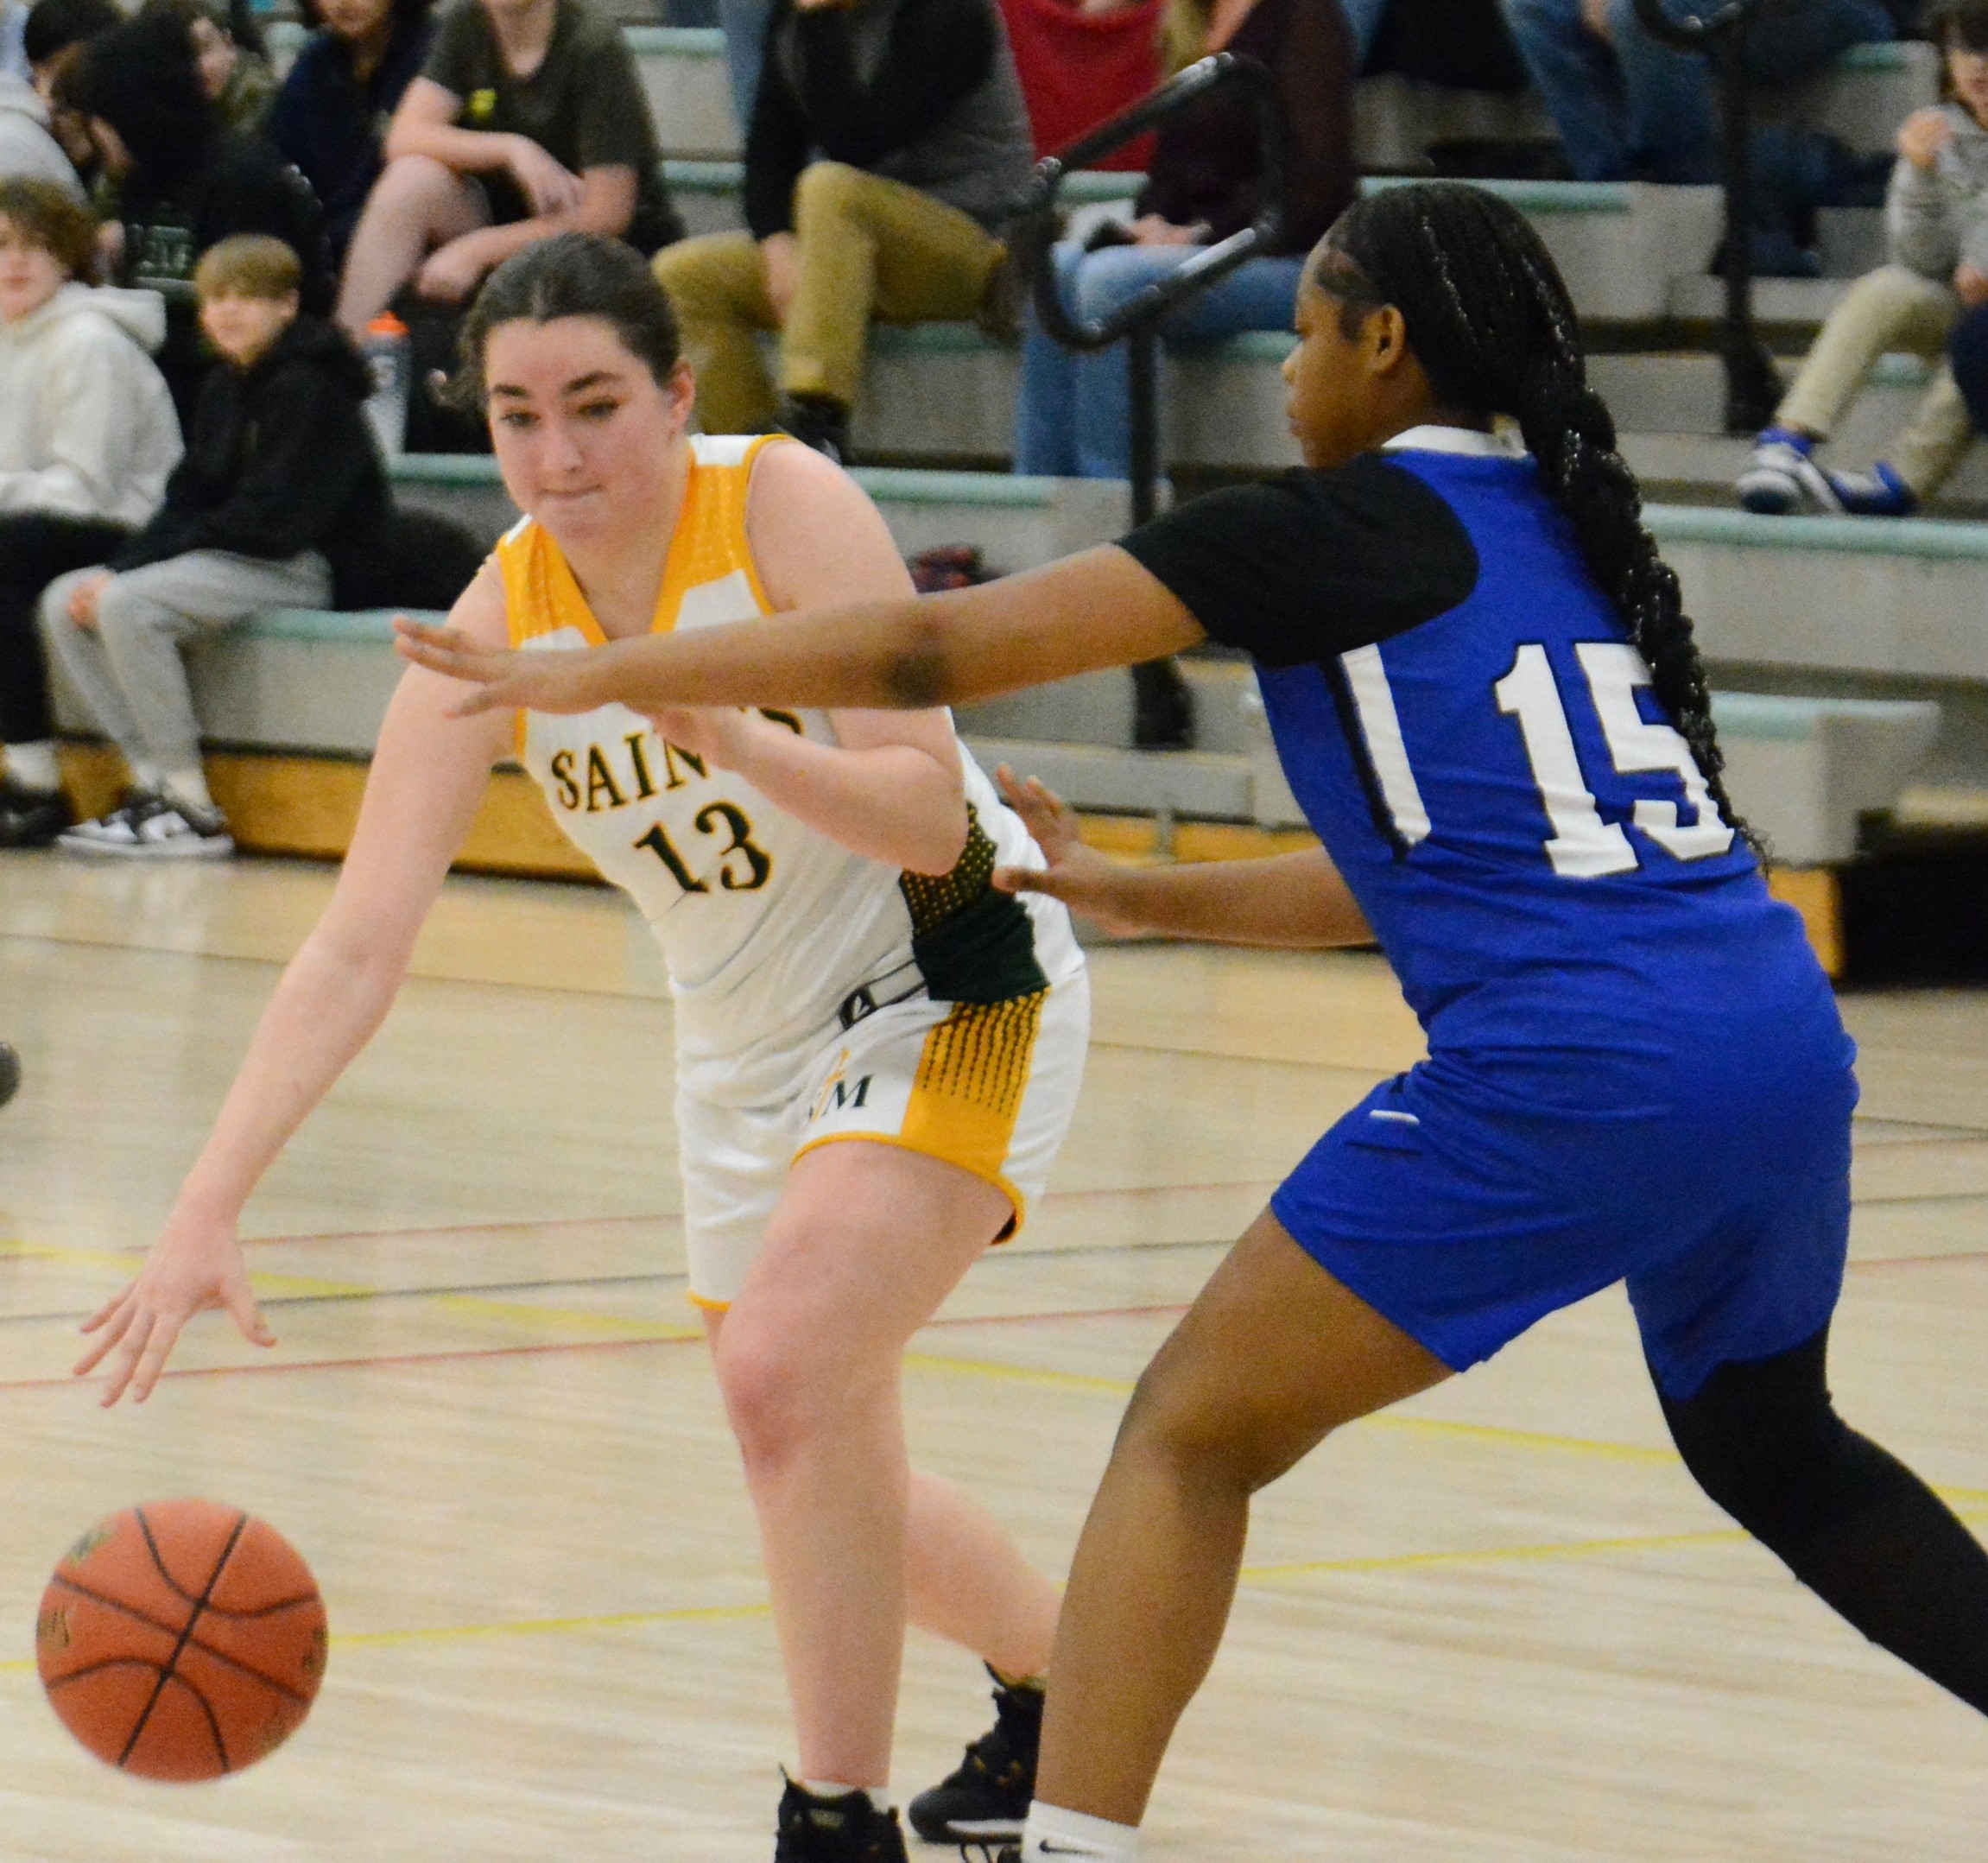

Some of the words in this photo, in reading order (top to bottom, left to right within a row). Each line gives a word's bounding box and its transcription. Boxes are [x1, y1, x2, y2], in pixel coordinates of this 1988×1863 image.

[551, 707, 804, 812] SAIN
[1495, 643, 1734, 878] 15
[631, 802, 772, 893] 13
